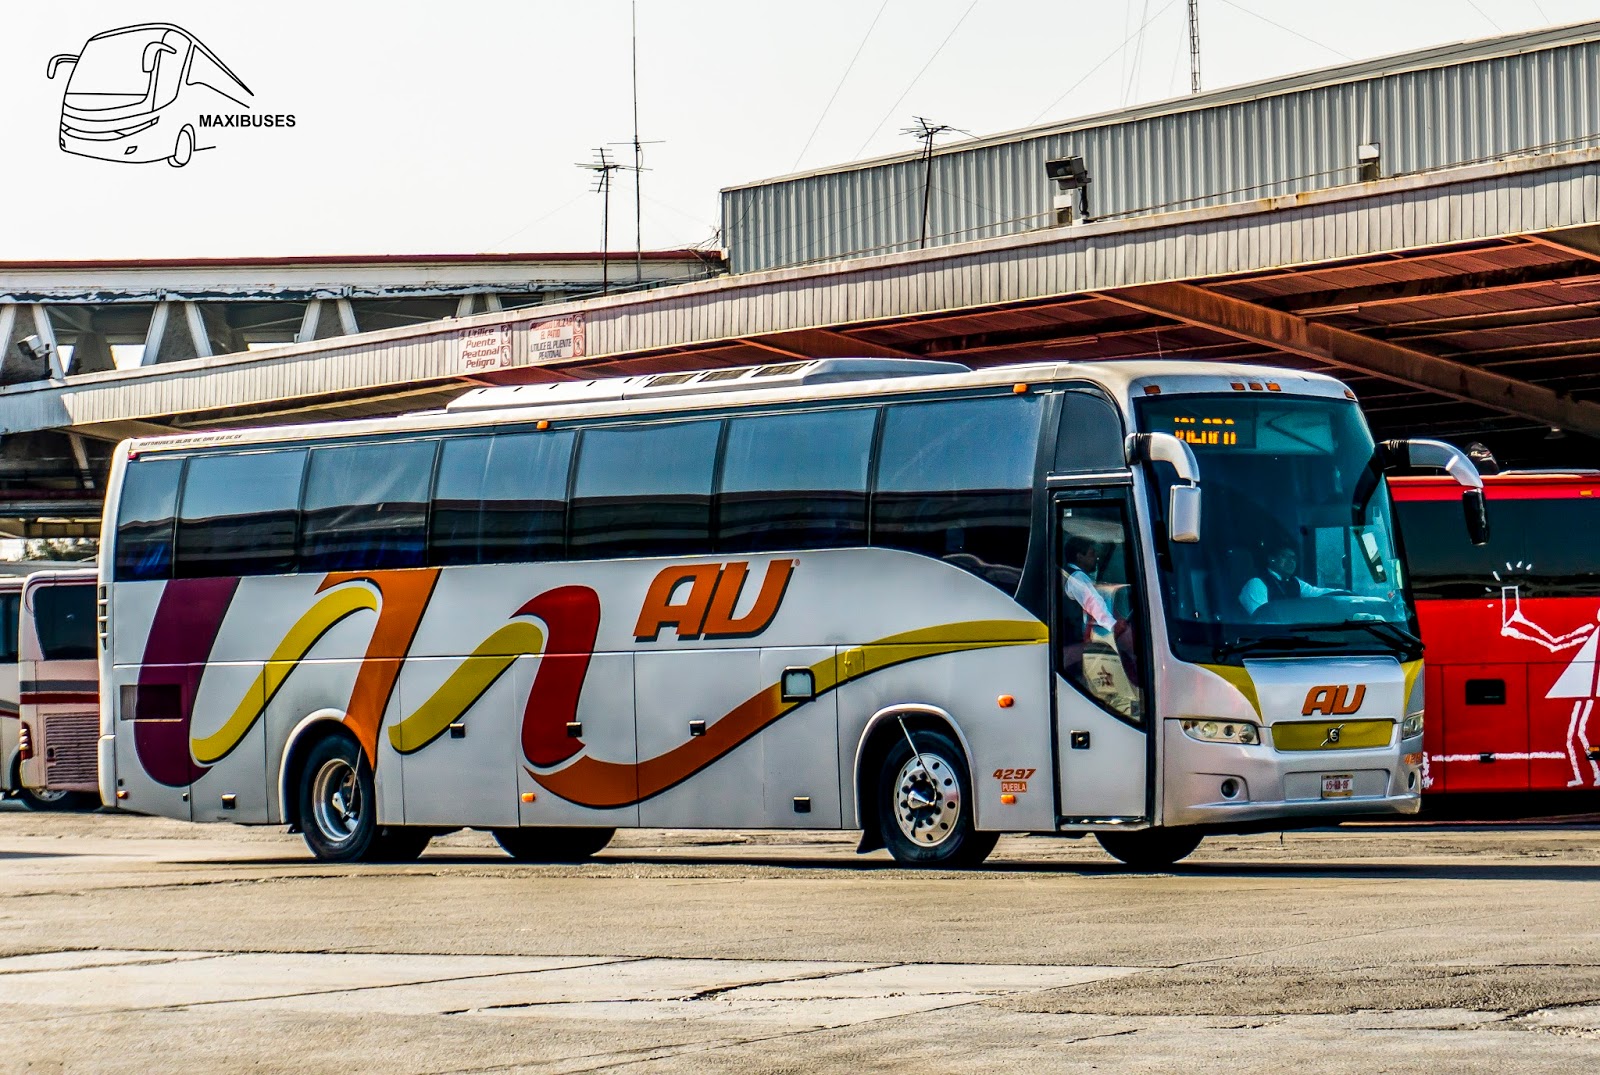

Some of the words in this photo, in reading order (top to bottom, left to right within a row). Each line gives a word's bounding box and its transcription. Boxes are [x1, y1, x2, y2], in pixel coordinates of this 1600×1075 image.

[465, 338, 496, 349] Puente
[461, 346, 500, 360] Peatonal
[465, 358, 495, 370] Peligro
[632, 559, 796, 643] AU
[1301, 684, 1367, 716] AU
[992, 768, 1036, 780] 4297
[1002, 782, 1027, 792] PUEBLA
